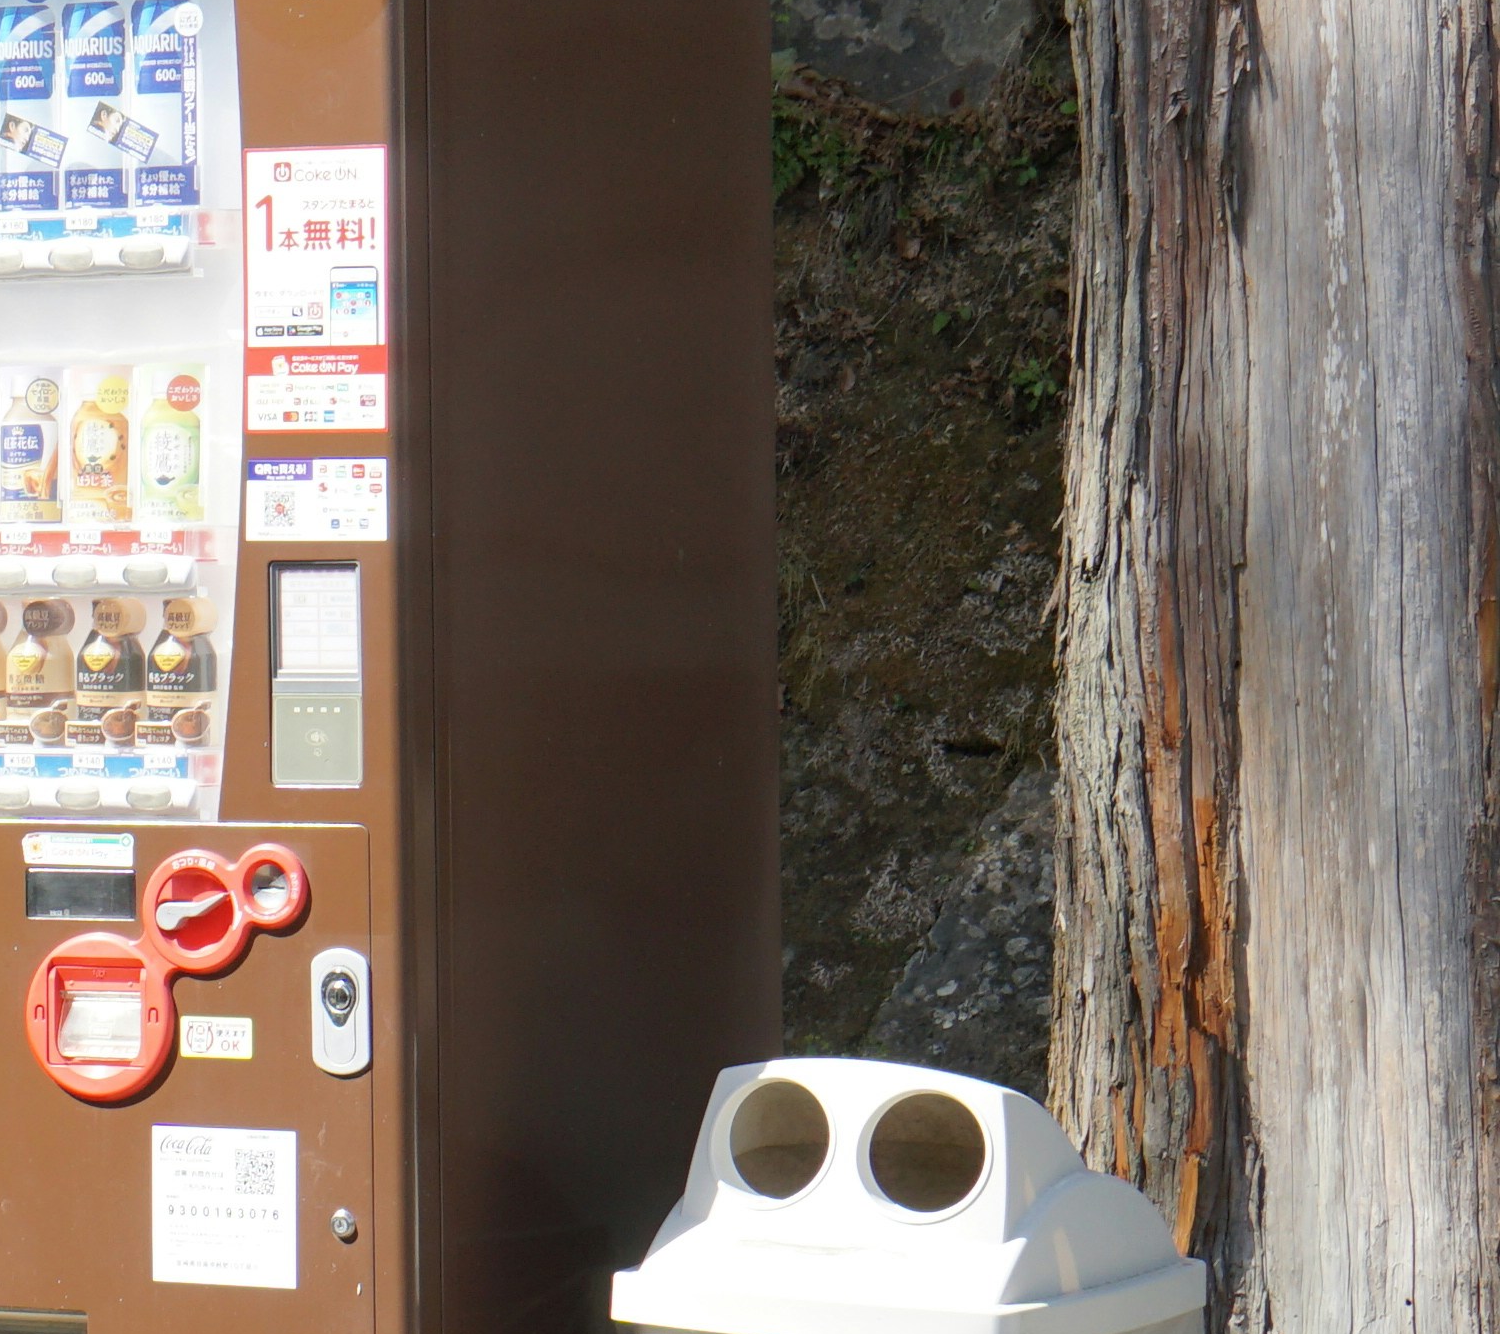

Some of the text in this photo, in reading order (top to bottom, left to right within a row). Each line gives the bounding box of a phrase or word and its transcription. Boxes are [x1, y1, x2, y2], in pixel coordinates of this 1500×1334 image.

[15, 76, 45, 88] 600ml
[85, 71, 115, 85] 600ml
[294, 166, 357, 182] Coke ON
[1, 189, 40, 201] 水分補給
[71, 186, 109, 199] 水分補給
[141, 183, 181, 197] 水分補給
[302, 198, 375, 210] スタンプたまると
[291, 361, 320, 373] Coke
[337, 361, 359, 375] Pay
[168, 386, 201, 395] こだわりの
[171, 394, 198, 402] おいしさ
[258, 413, 278, 421] VISA
[254, 463, 307, 475] QRで買える！
[76, 474, 114, 488] ほうじ茶
[220, 1039, 240, 1051] OK
